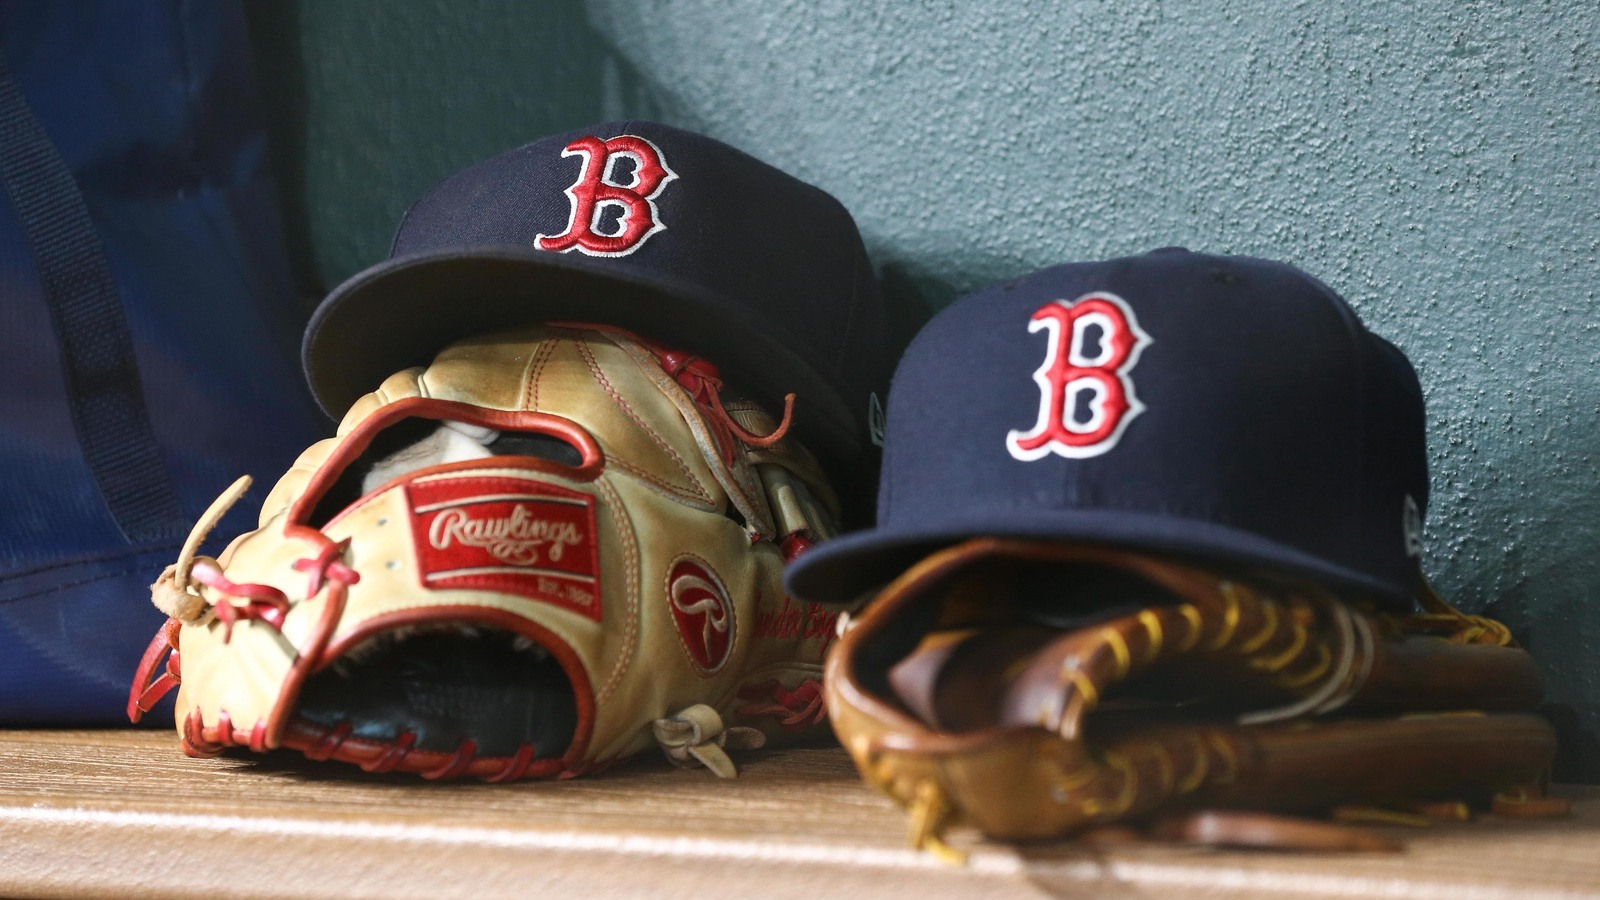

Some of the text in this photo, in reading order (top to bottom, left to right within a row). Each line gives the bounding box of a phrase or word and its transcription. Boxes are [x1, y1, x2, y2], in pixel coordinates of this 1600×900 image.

[534, 135, 679, 258] B
[1006, 292, 1154, 461] B
[429, 503, 583, 565] Rawlings
